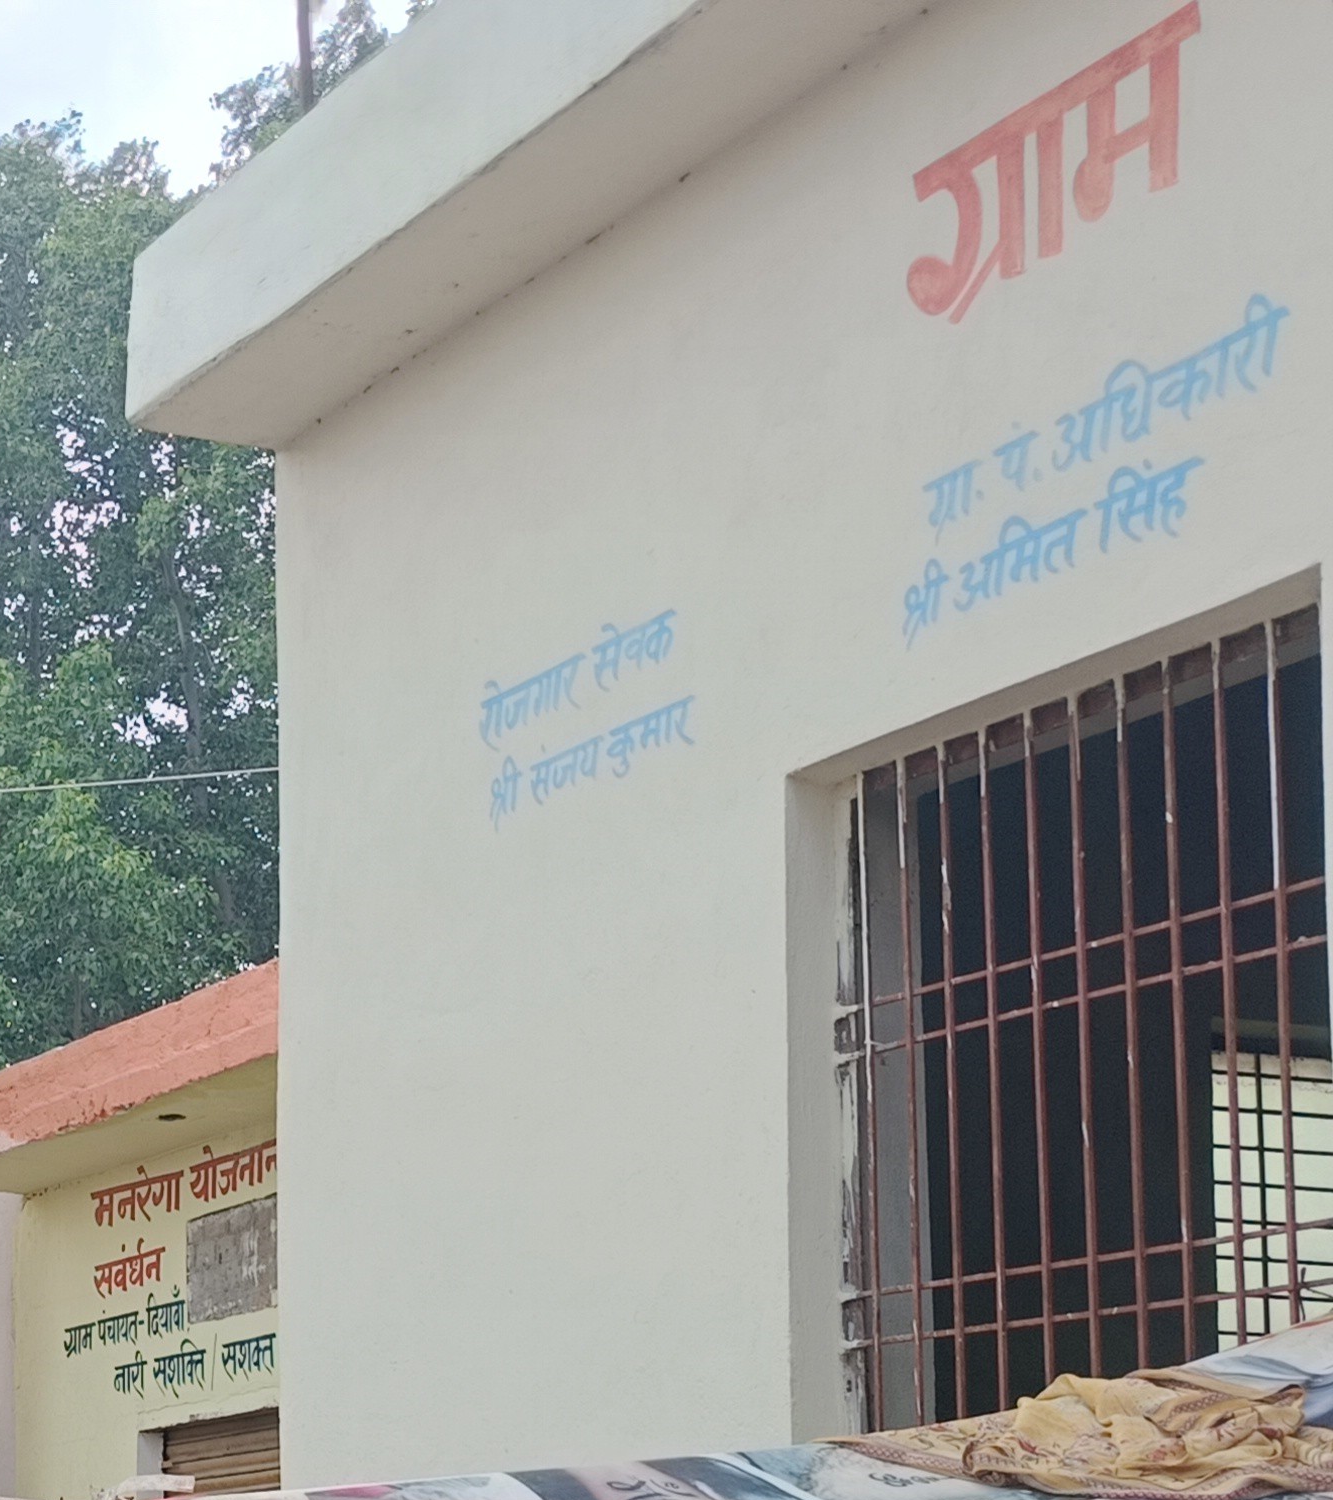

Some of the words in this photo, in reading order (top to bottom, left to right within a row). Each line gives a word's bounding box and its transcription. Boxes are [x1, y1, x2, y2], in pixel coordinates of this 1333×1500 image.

[906, 0, 1201, 324] ग्राम
[1052, 293, 1291, 473] अधिकारी
[903, 558, 949, 652] श्री
[954, 516, 1088, 612] अमित
[1094, 455, 1206, 554] सिंह
[479, 680, 587, 753] रोजगार
[592, 608, 677, 692] सेवक
[490, 755, 523, 833] श्री
[530, 735, 604, 806] संजय
[607, 695, 695, 779] कुमार
[91, 1165, 184, 1227] मनरेगा
[64, 1322, 96, 1358] ग्राम
[114, 1350, 147, 1399] नारी
[221, 1332, 278, 1382] सशक्त
